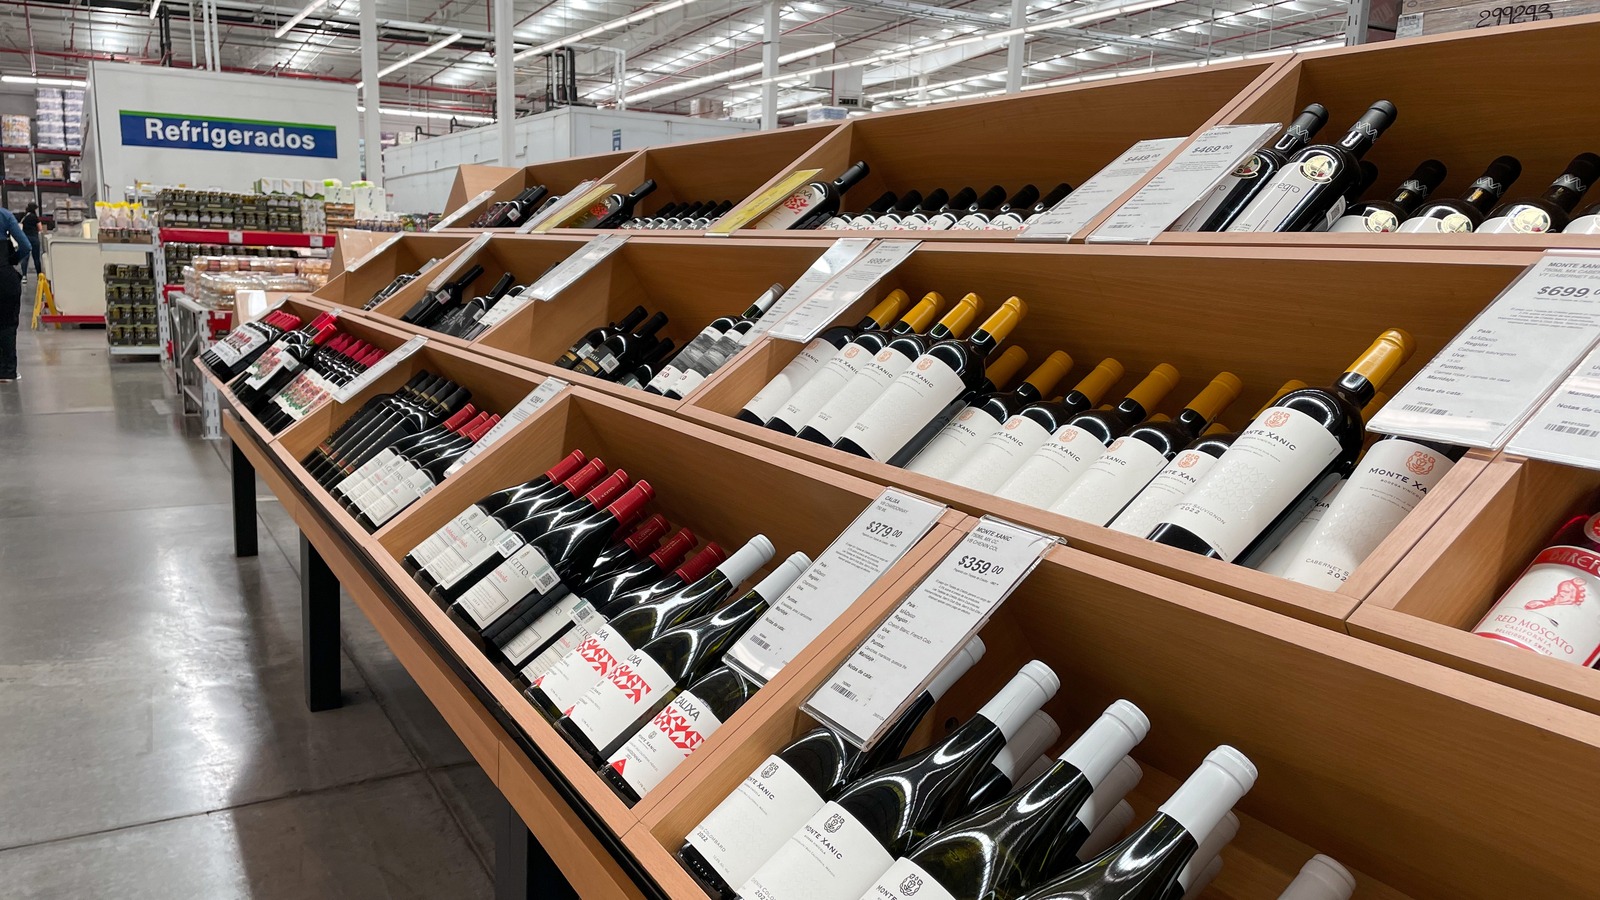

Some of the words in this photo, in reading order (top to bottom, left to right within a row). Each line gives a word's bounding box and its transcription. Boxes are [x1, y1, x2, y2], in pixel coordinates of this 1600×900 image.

[1476, 4, 1554, 28] 299293
[145, 118, 316, 150] Refrigerados
[876, 365, 893, 379] XANIC
[916, 373, 934, 388] XANIC
[958, 422, 976, 436] XANIC
[1002, 431, 1024, 446] XANIC
[1266, 432, 1297, 450] XANIC
[1058, 445, 1081, 462] XANIC
[1105, 454, 1127, 466] XANIC
[1368, 468, 1410, 484] MONTE
[1180, 505, 1200, 515] 2022
[1192, 502, 1226, 525] SAUVIGNON
[892, 530, 903, 538] 00
[976, 527, 995, 537] MONTE
[995, 533, 1012, 542] XANIC
[991, 565, 1004, 575] 00
[1305, 558, 1342, 572] CABERNET
[1494, 614, 1518, 624] RED
[1520, 619, 1574, 655] MOSCATO
[1495, 628, 1532, 646] DELICIOUSLY
[1534, 643, 1552, 656] SWEET
[1504, 624, 1551, 648] CALIFORNIA
[674, 696, 701, 722] CALIXA
[757, 784, 775, 800] XANIC
[703, 828, 726, 852] COLOMBARD
[820, 837, 843, 860] XANIC
